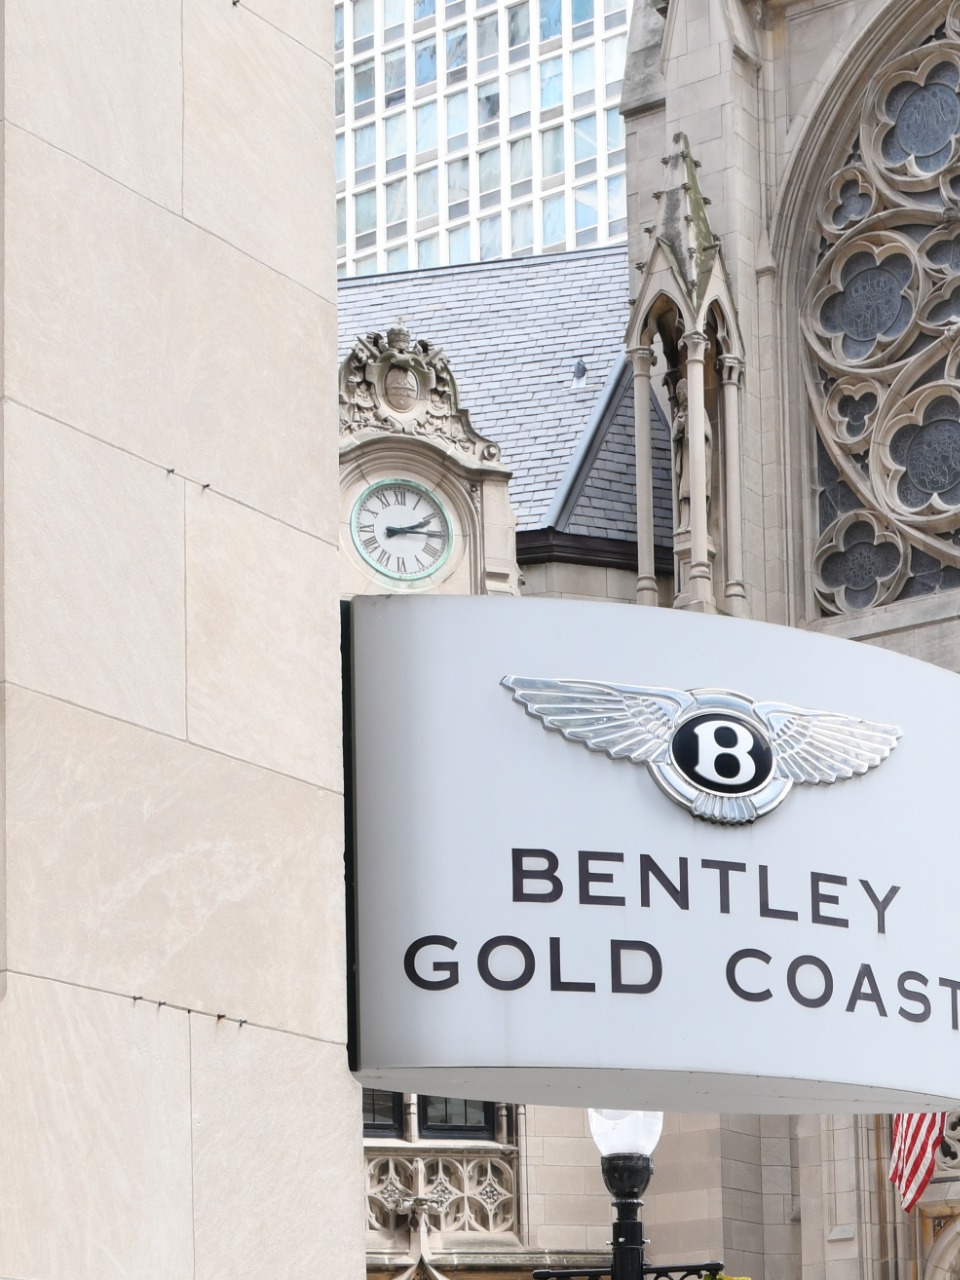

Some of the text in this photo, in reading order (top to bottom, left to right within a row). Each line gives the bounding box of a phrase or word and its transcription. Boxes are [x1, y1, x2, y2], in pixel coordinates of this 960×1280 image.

[694, 720, 757, 785] B
[511, 847, 901, 935] BENTLEY
[403, 934, 663, 994] GOLD
